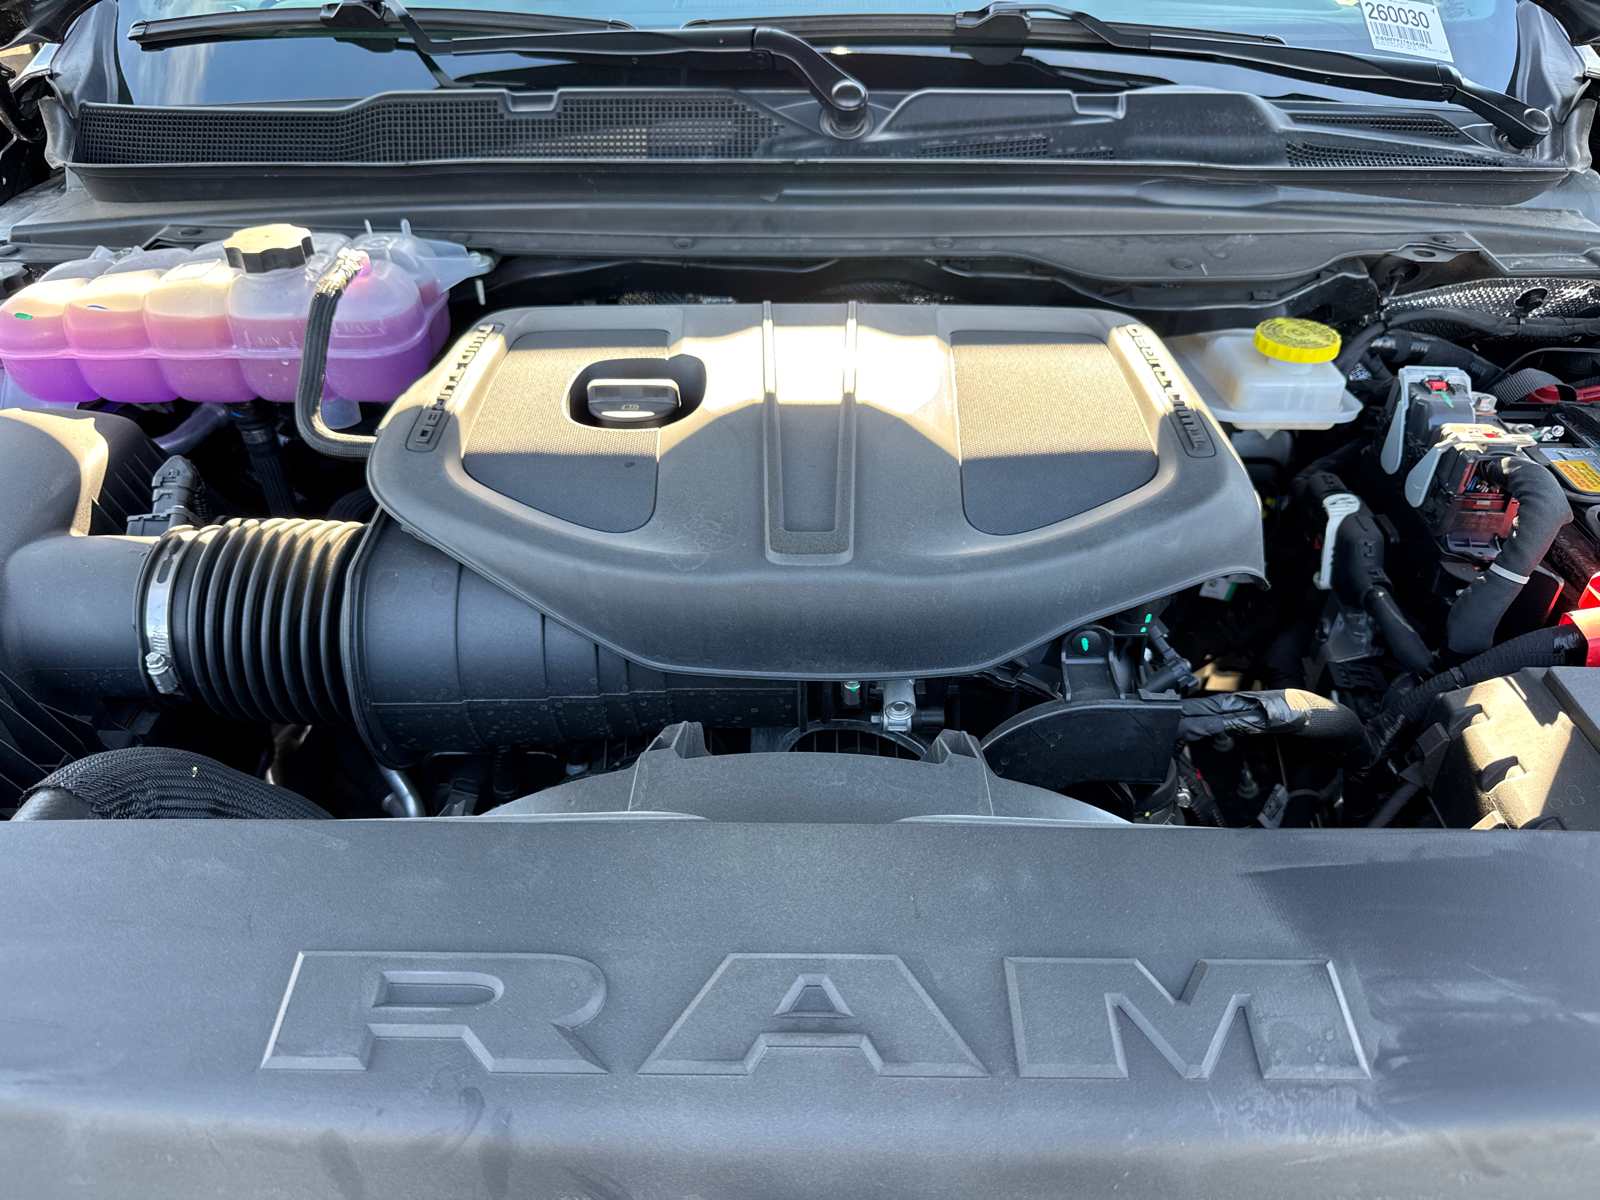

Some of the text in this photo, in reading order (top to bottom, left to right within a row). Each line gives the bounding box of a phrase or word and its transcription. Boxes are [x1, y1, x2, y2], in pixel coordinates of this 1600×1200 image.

[1365, 2, 1430, 28] 260030
[258, 336, 281, 347] MIN
[343, 323, 372, 334] MAX
[415, 364, 466, 443] TURBO
[1125, 324, 1205, 450] TWIN TURBO
[260, 950, 1375, 1080] RAM
